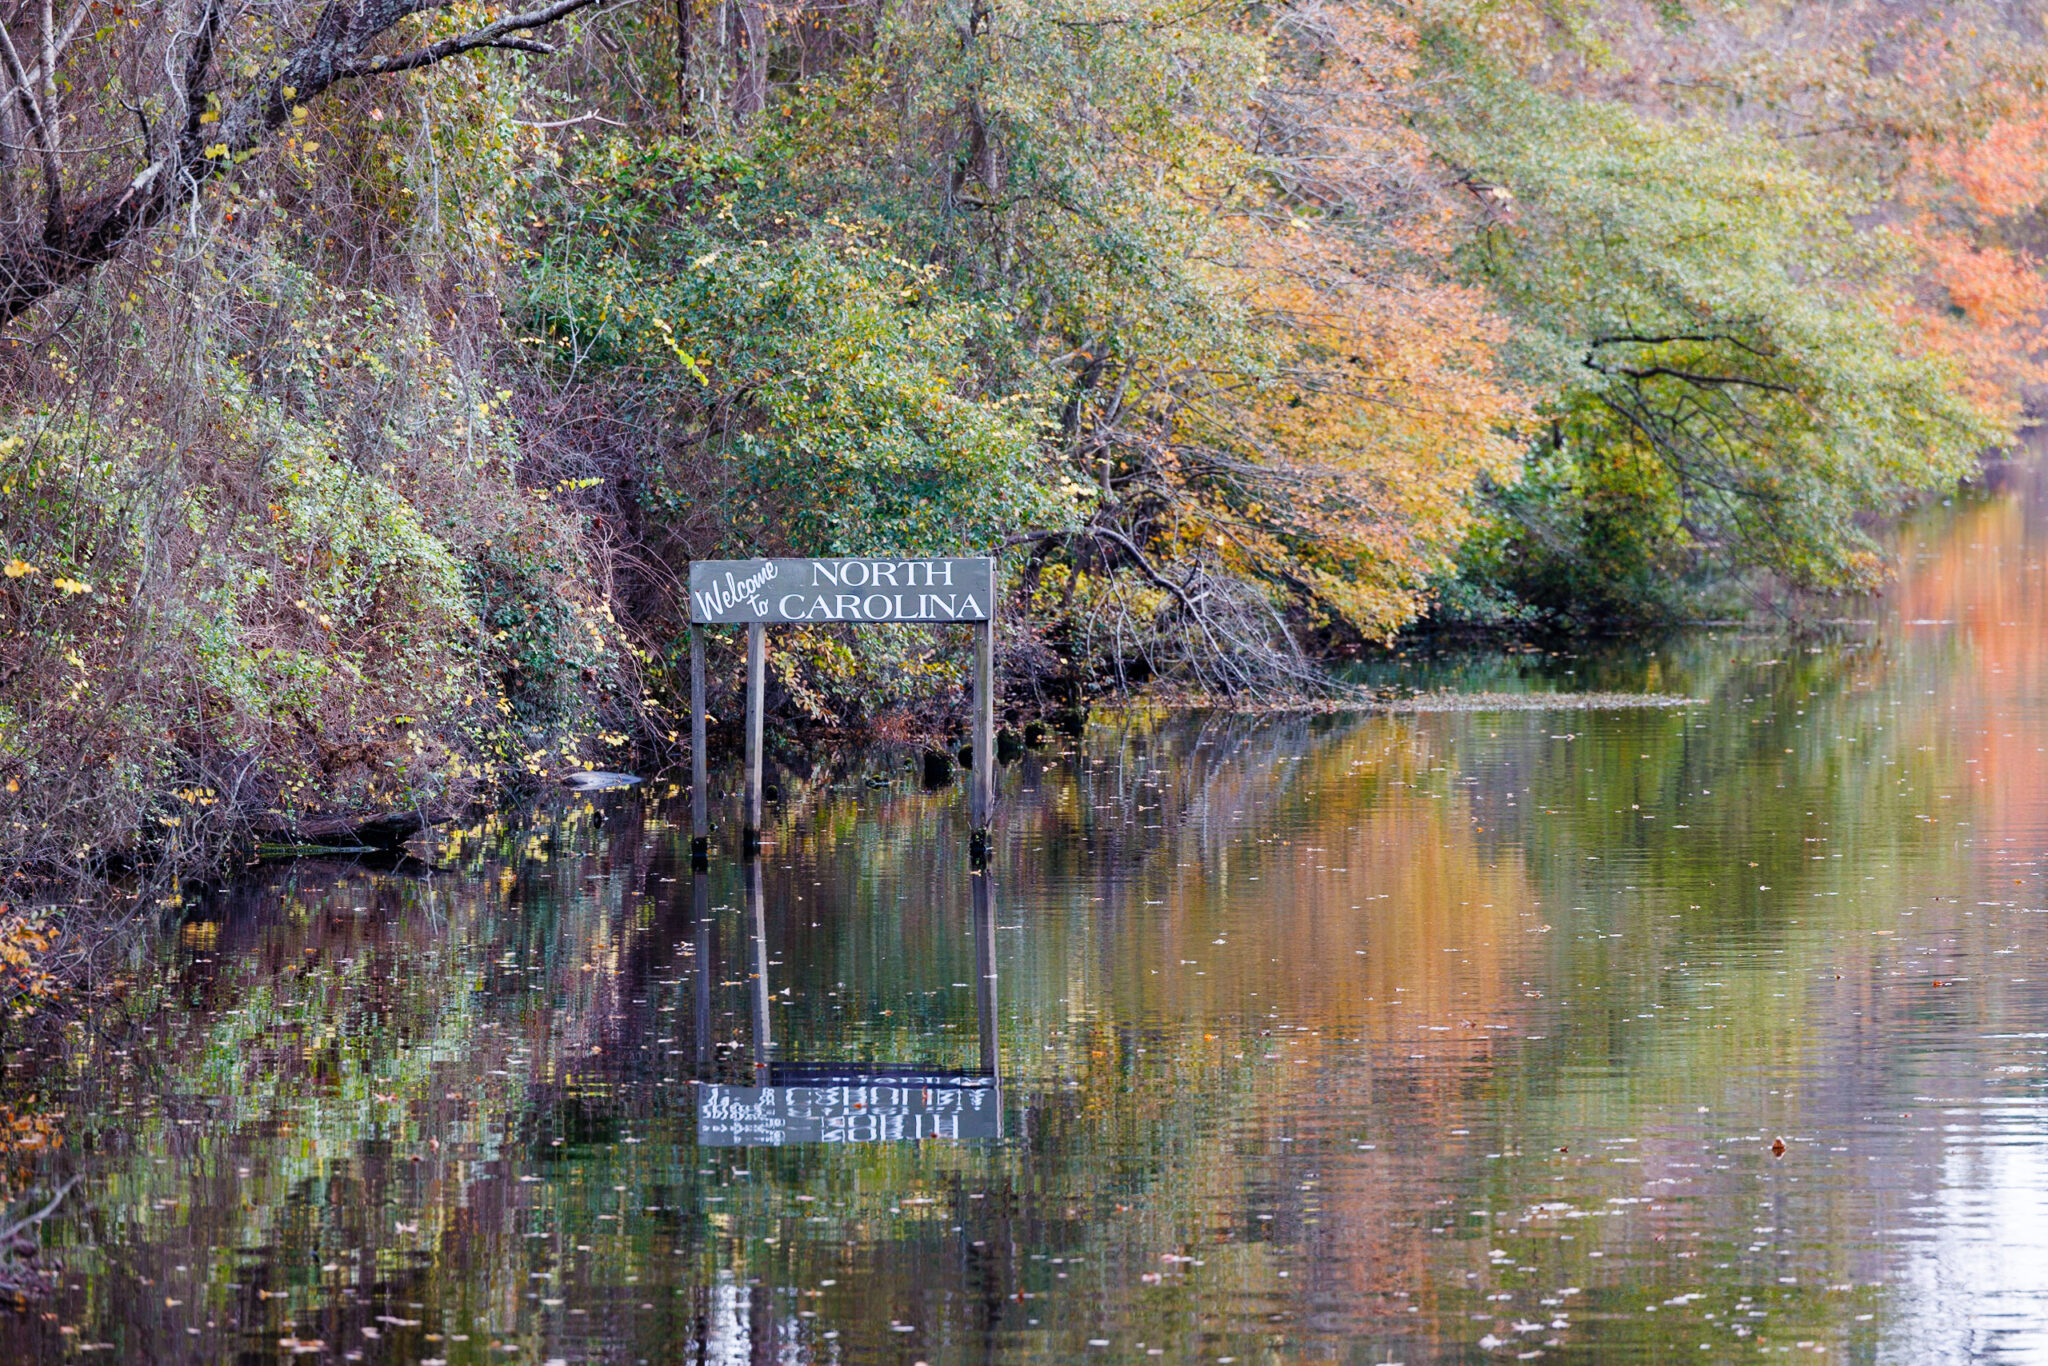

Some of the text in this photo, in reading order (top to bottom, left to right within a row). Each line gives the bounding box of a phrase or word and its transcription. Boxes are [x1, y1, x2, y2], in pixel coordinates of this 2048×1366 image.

[811, 561, 953, 587] NORTH
[695, 561, 778, 621] Welcome
[747, 590, 769, 617] to
[779, 594, 986, 620] CAROLINA
